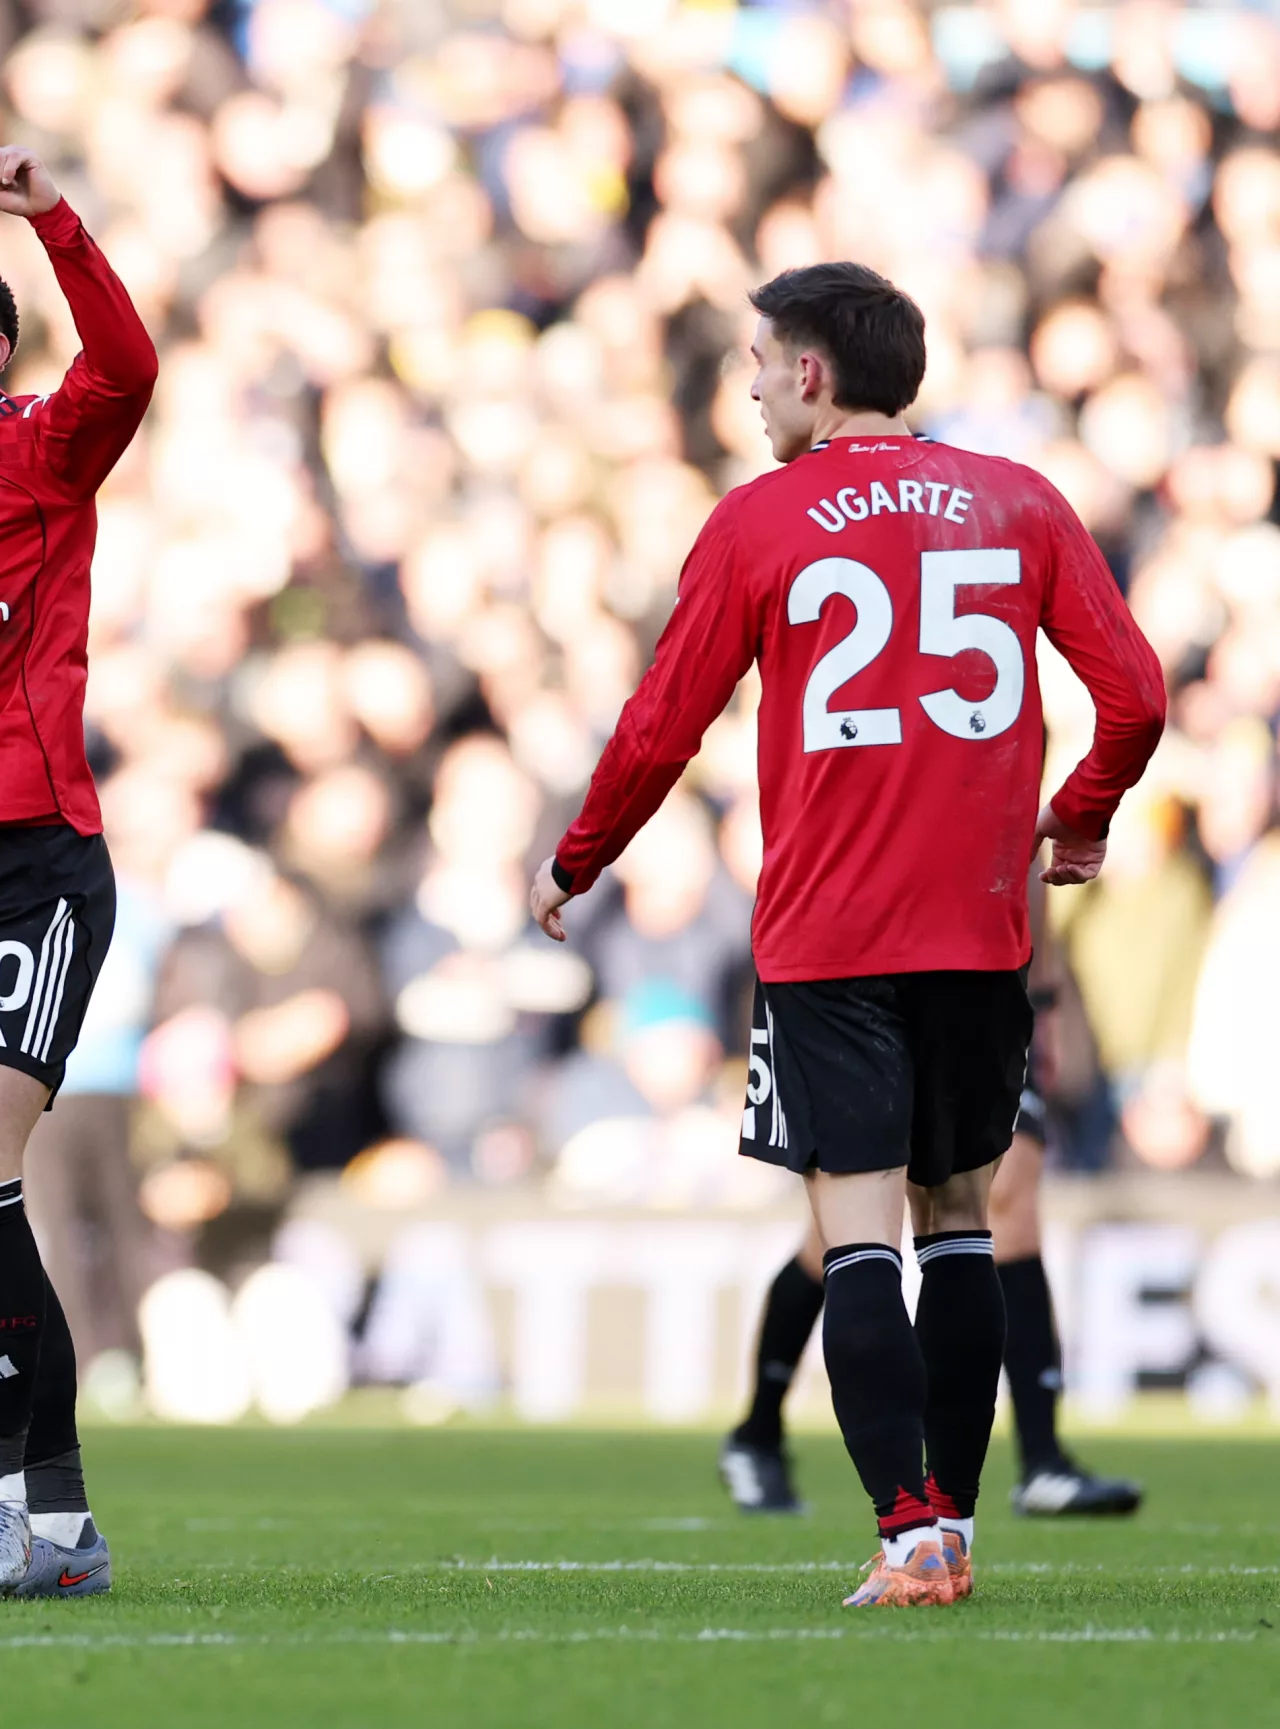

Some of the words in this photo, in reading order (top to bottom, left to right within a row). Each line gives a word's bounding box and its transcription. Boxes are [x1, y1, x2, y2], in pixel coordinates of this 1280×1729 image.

[806, 480, 974, 533] UGARTE
[787, 548, 1025, 754] 25
[746, 1028, 771, 1105] 5
